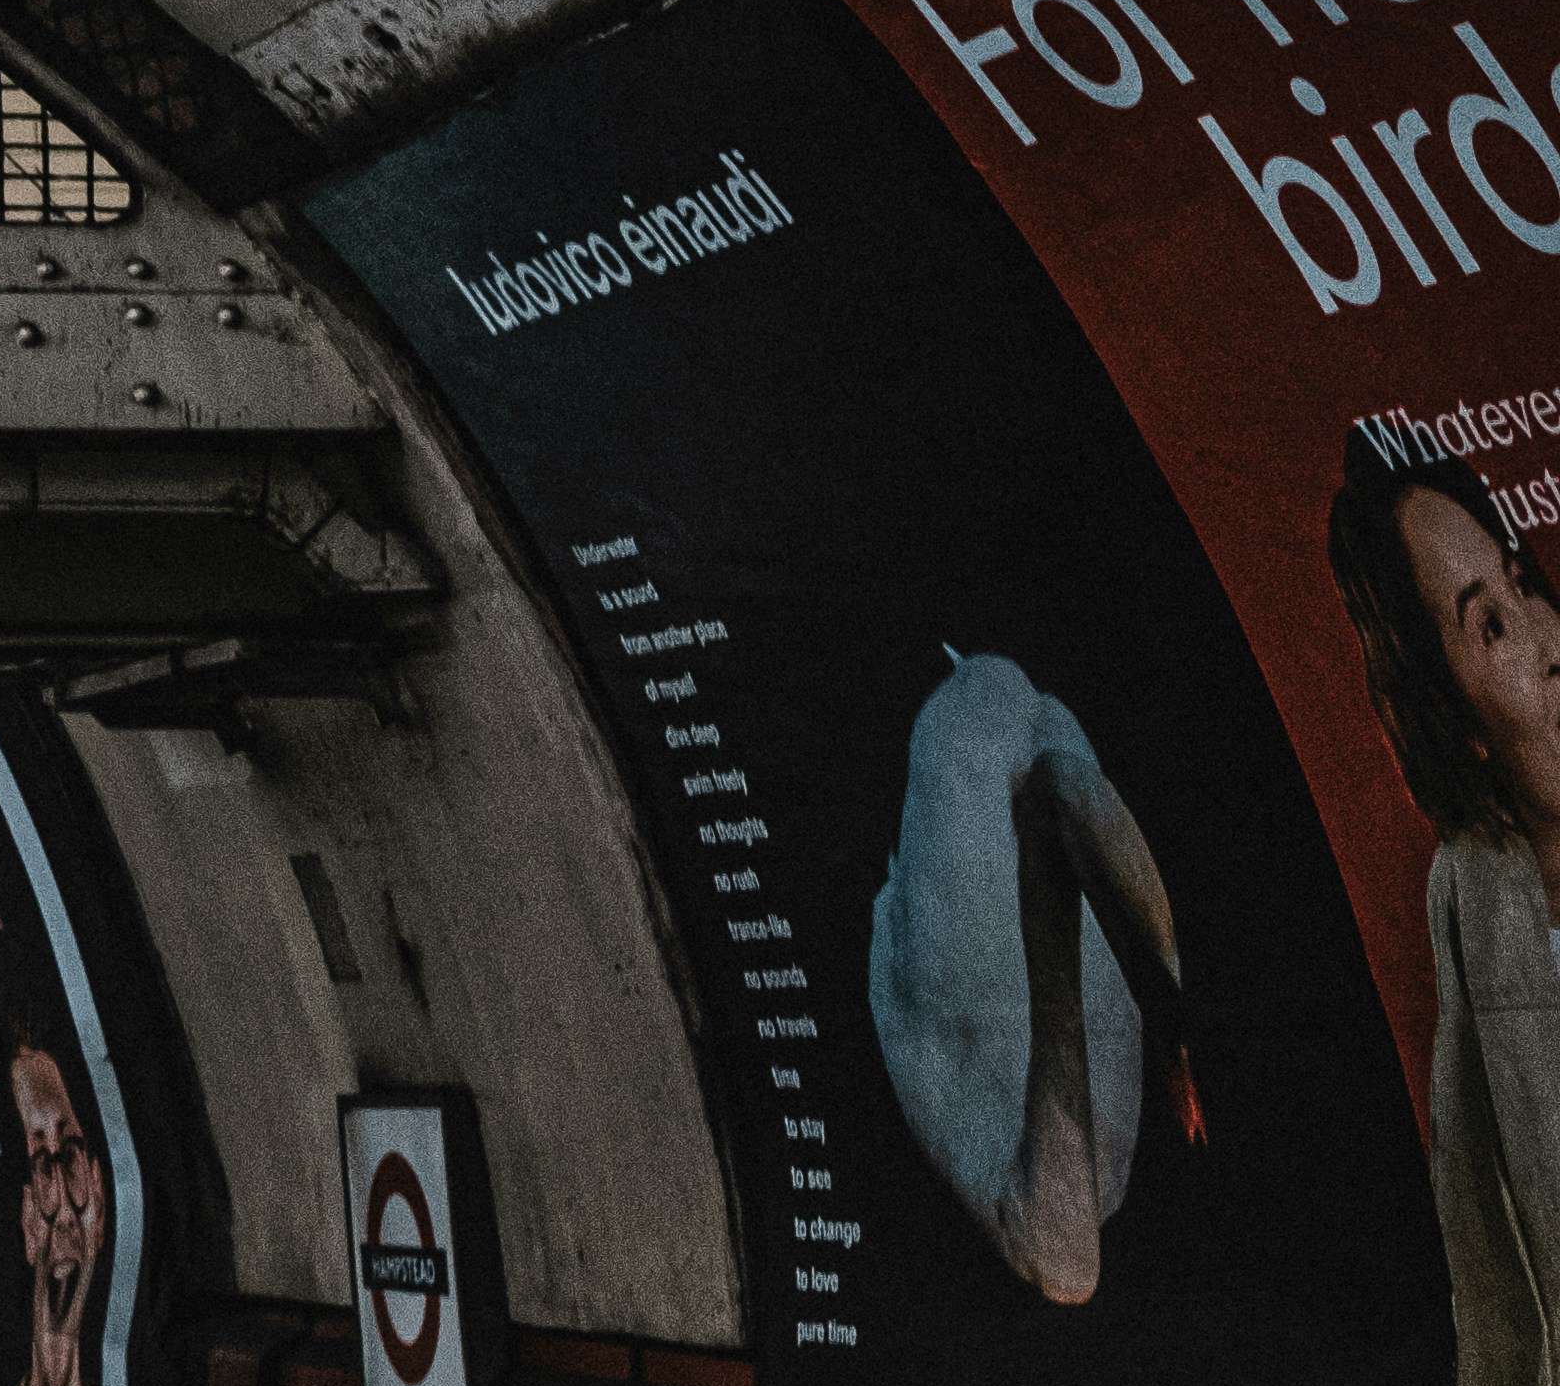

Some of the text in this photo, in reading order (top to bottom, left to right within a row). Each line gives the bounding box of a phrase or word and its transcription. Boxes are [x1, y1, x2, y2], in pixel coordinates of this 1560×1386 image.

[1197, 19, 1560, 315] bird
[445, 148, 794, 336] ludovico einaudi
[1354, 386, 1560, 471] Whateve
[793, 1215, 861, 1250] to change
[795, 1266, 840, 1294] to love
